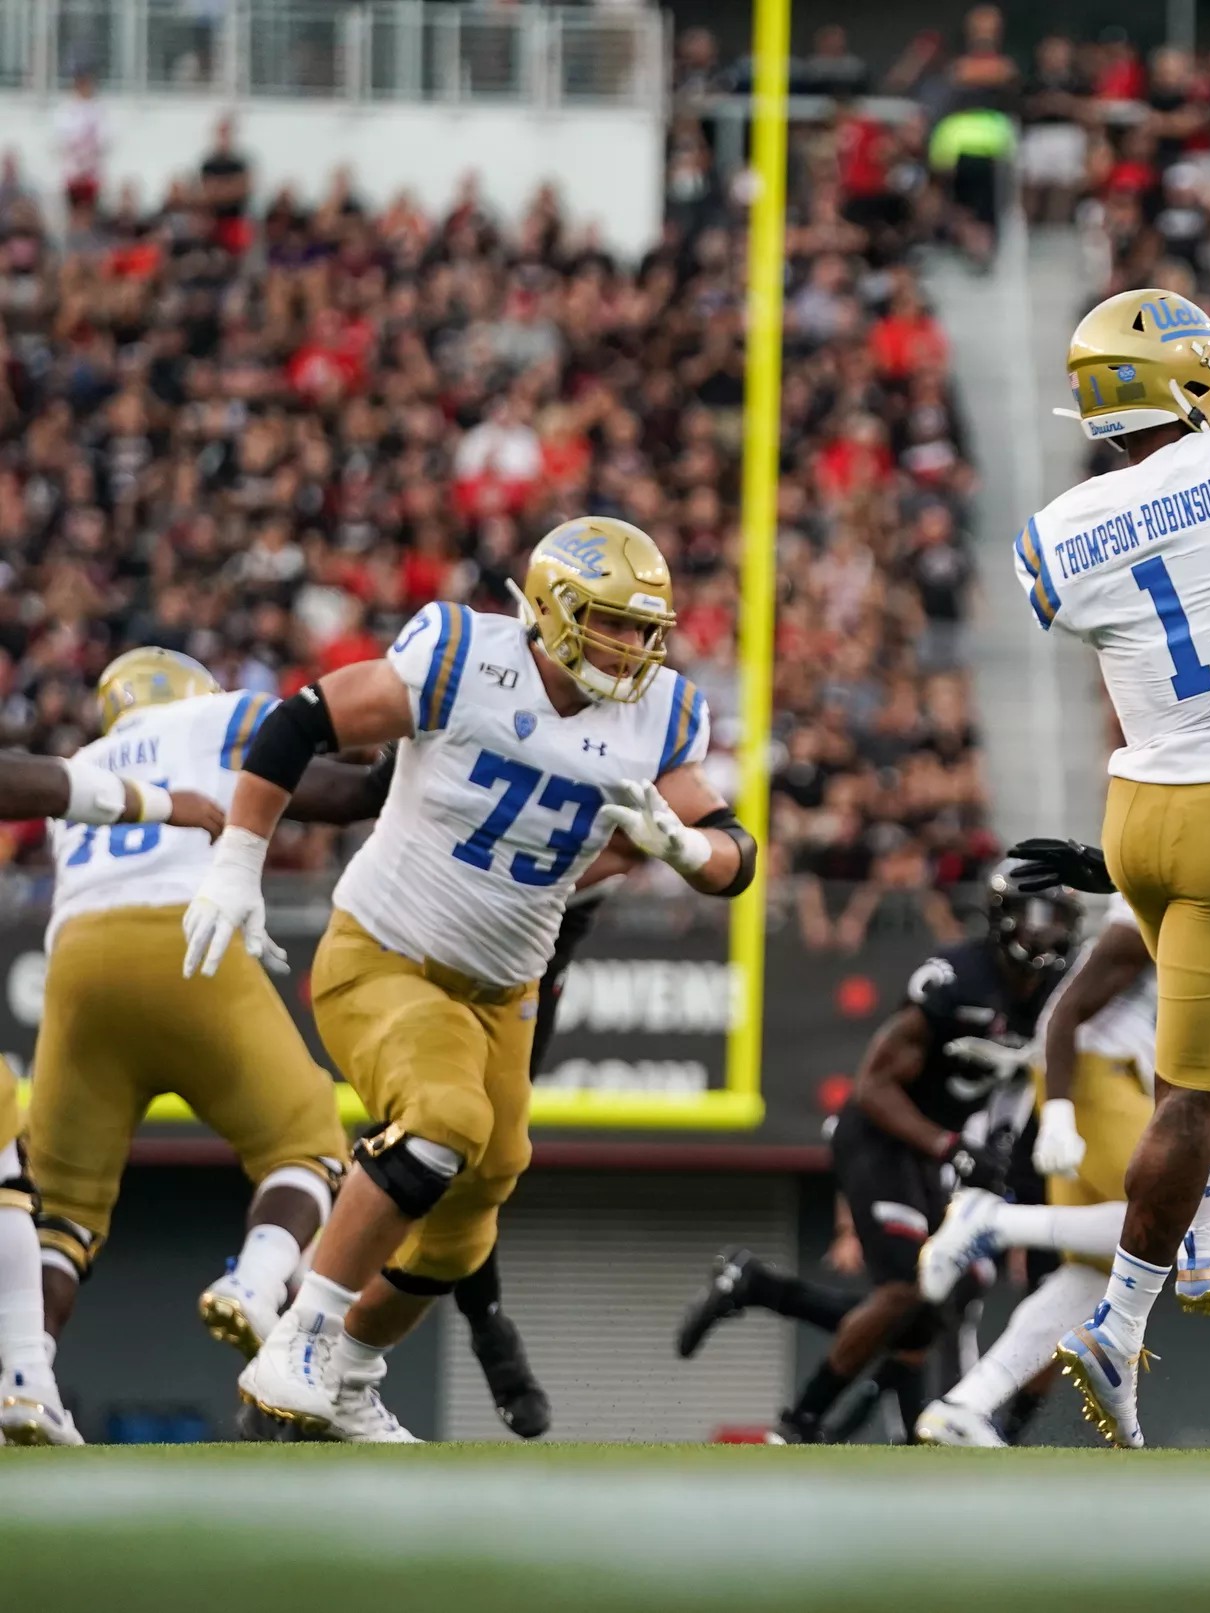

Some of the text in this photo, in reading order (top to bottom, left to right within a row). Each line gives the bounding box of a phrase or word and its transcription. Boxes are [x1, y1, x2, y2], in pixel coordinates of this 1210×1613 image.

[1088, 421, 1126, 437] Bruins
[479, 661, 520, 690] 150
[452, 749, 605, 887] 73
